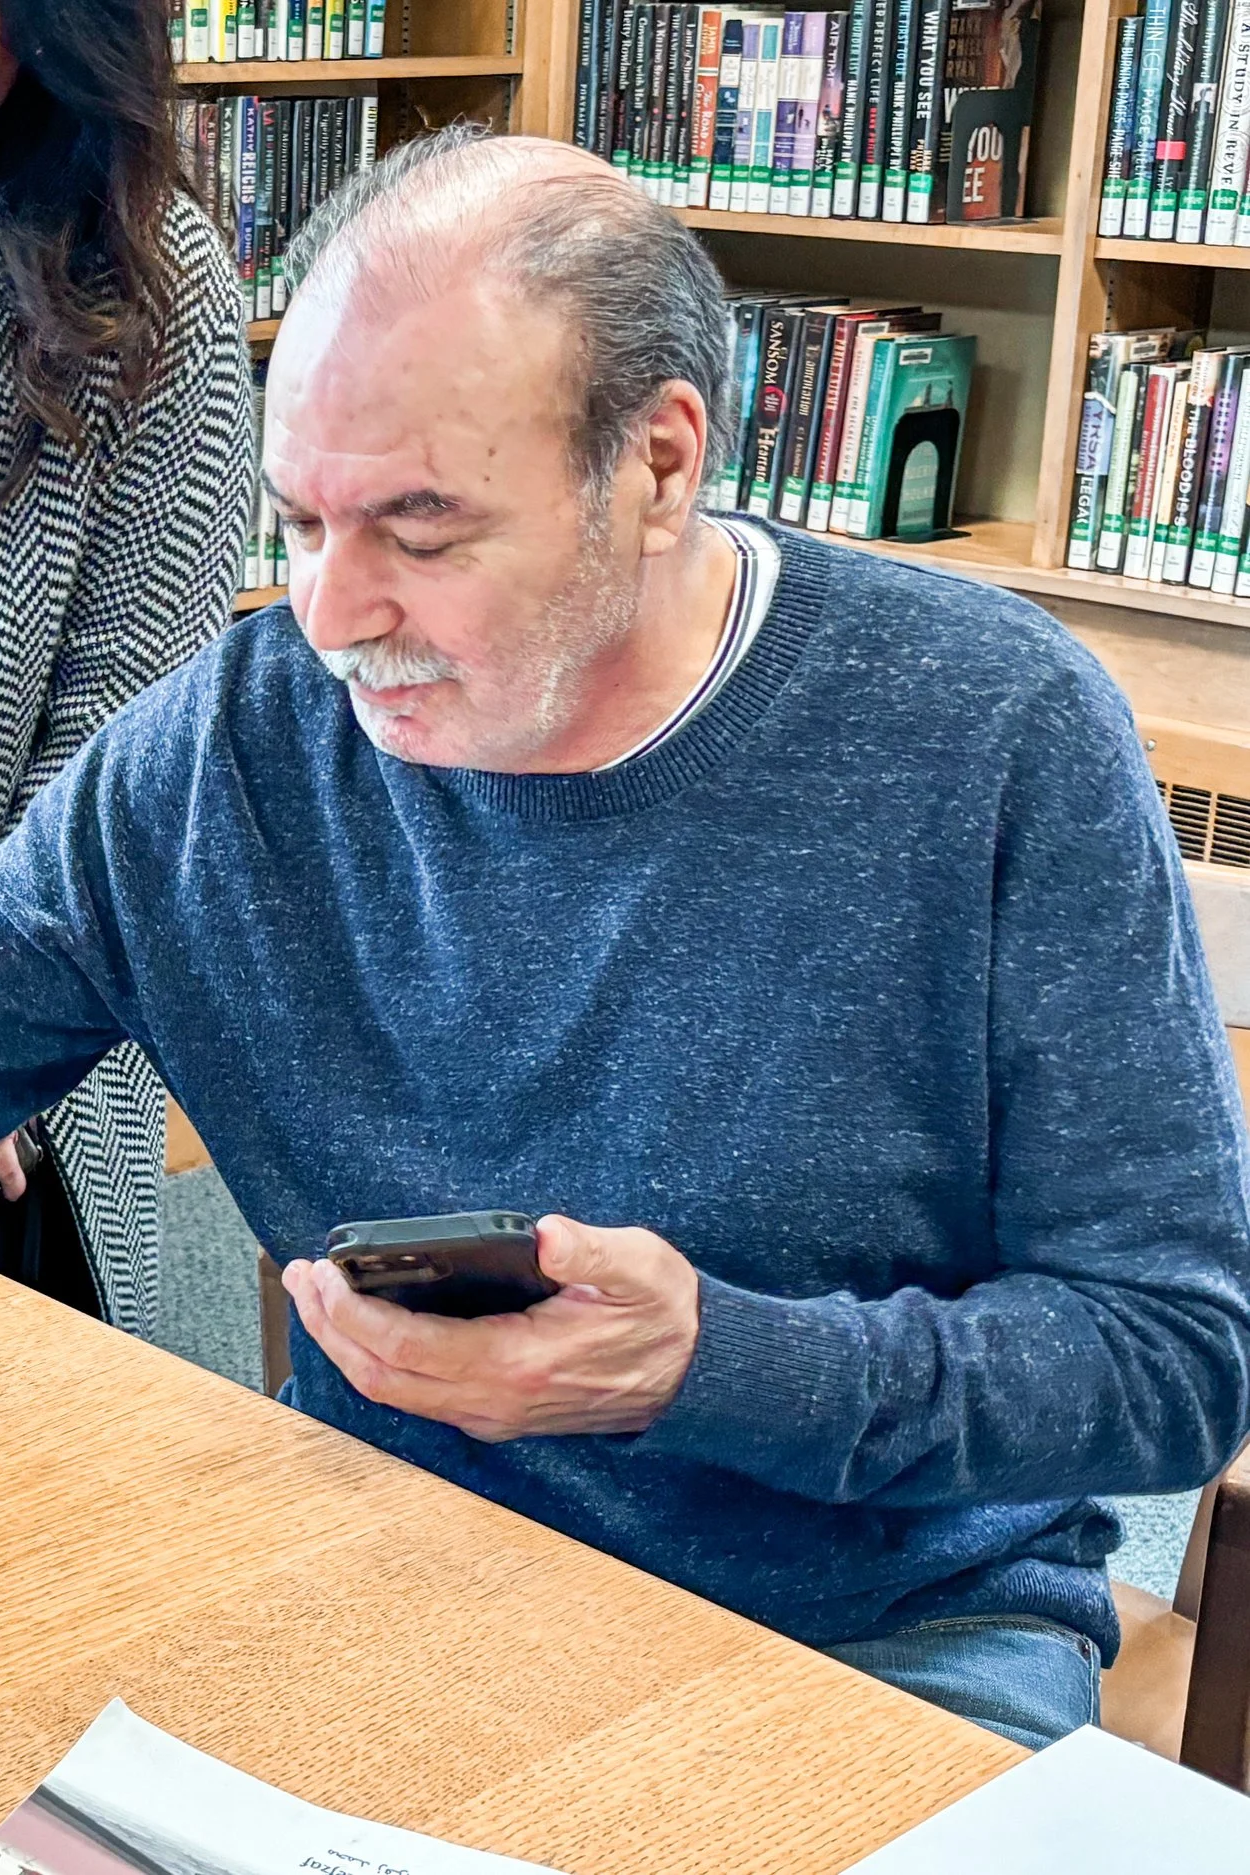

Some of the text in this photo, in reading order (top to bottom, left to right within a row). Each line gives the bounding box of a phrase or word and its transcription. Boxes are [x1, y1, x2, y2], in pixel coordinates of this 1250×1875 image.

[621, 10, 633, 38] Betty
[854, 0, 864, 16] THE
[900, 0, 910, 18] THE
[685, 23, 695, 47] Land
[850, 19, 862, 54] MURDER
[872, 21, 885, 74] PERFECT
[897, 20, 908, 45] FIRST
[619, 41, 631, 90] Rowlands
[634, 18, 648, 108] Covenant with Hell
[826, 20, 839, 88] AIR TIME
[848, 57, 860, 76] LIST
[895, 63, 905, 76] LIE
[896, 48, 907, 60] TO
[916, 11, 939, 119] WHAT YOU SEE
[946, 60, 976, 78] RYAN
[1200, 28, 1216, 78] shepherd
[669, 73, 676, 82] OF
[845, 79, 857, 104] HANK
[869, 78, 881, 103] LIFE
[893, 81, 904, 108] HANK
[1110, 24, 1137, 157] THE BURNING PAGES PAIGE
[1135, 8, 1166, 180] THIN ICE PAIGE SHELT
[335, 112, 343, 127] The
[1165, 90, 1187, 139] House
[1221, 23, 1250, 185] A STUDY IN REVE
[319, 112, 330, 158] Tigerlily's
[700, 111, 712, 138] ROAD
[842, 107, 854, 149] PHILLIPPI
[890, 110, 903, 157] PHILLIPPI
[241, 108, 256, 204] KATHY REICHS
[280, 133, 289, 171] Monster
[302, 132, 311, 158] Man's
[334, 143, 342, 161] Zita
[366, 138, 377, 166] REND
[867, 134, 876, 164] PHILLIP
[916, 139, 925, 174] PHILLIP
[962, 167, 985, 203] EE
[244, 227, 252, 260] BONES
[764, 321, 784, 385] SANSOM
[799, 344, 820, 416] Lamentation
[846, 415, 857, 451] SECRETS
[1187, 409, 1200, 434] THE
[755, 427, 780, 482] Heartsto
[1087, 410, 1103, 470] YRSA
[845, 455, 853, 464] OF
[1177, 439, 1197, 493] BLOOD
[1077, 476, 1093, 523] LEGA
[328, 1849, 370, 1867] محمد
